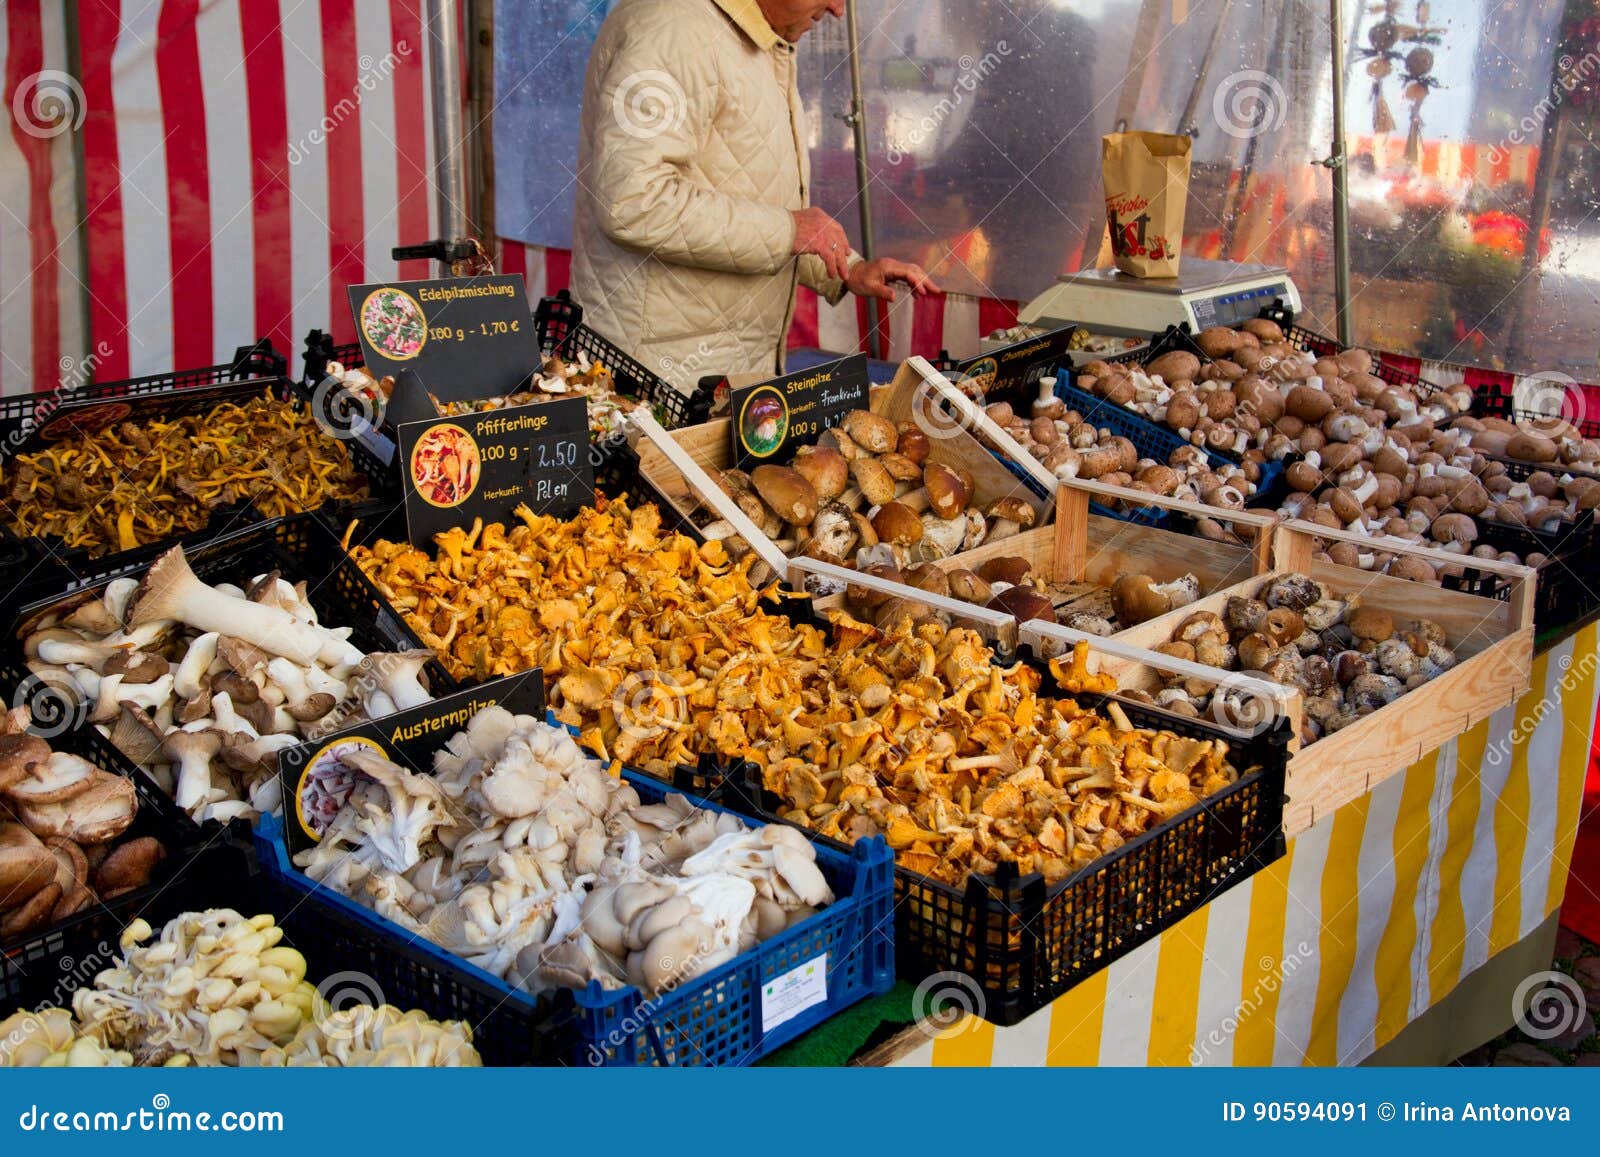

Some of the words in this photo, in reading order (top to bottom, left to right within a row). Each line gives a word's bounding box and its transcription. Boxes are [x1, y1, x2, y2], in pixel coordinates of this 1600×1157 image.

[418, 283, 515, 302] Edelpilzmischung
[429, 326, 452, 340] 100
[456, 329, 465, 341] g
[480, 321, 508, 336] 1,70
[510, 320, 520, 332] €
[786, 372, 832, 394] Steinpilze
[821, 384, 862, 407] Frankreich
[476, 415, 548, 436] Pfifferlinge
[790, 421, 808, 437] 100
[810, 422, 817, 434] g
[481, 445, 504, 461] 100
[509, 446, 517, 460] g
[538, 441, 577, 468] 2,50
[483, 485, 524, 500] Herkunft:
